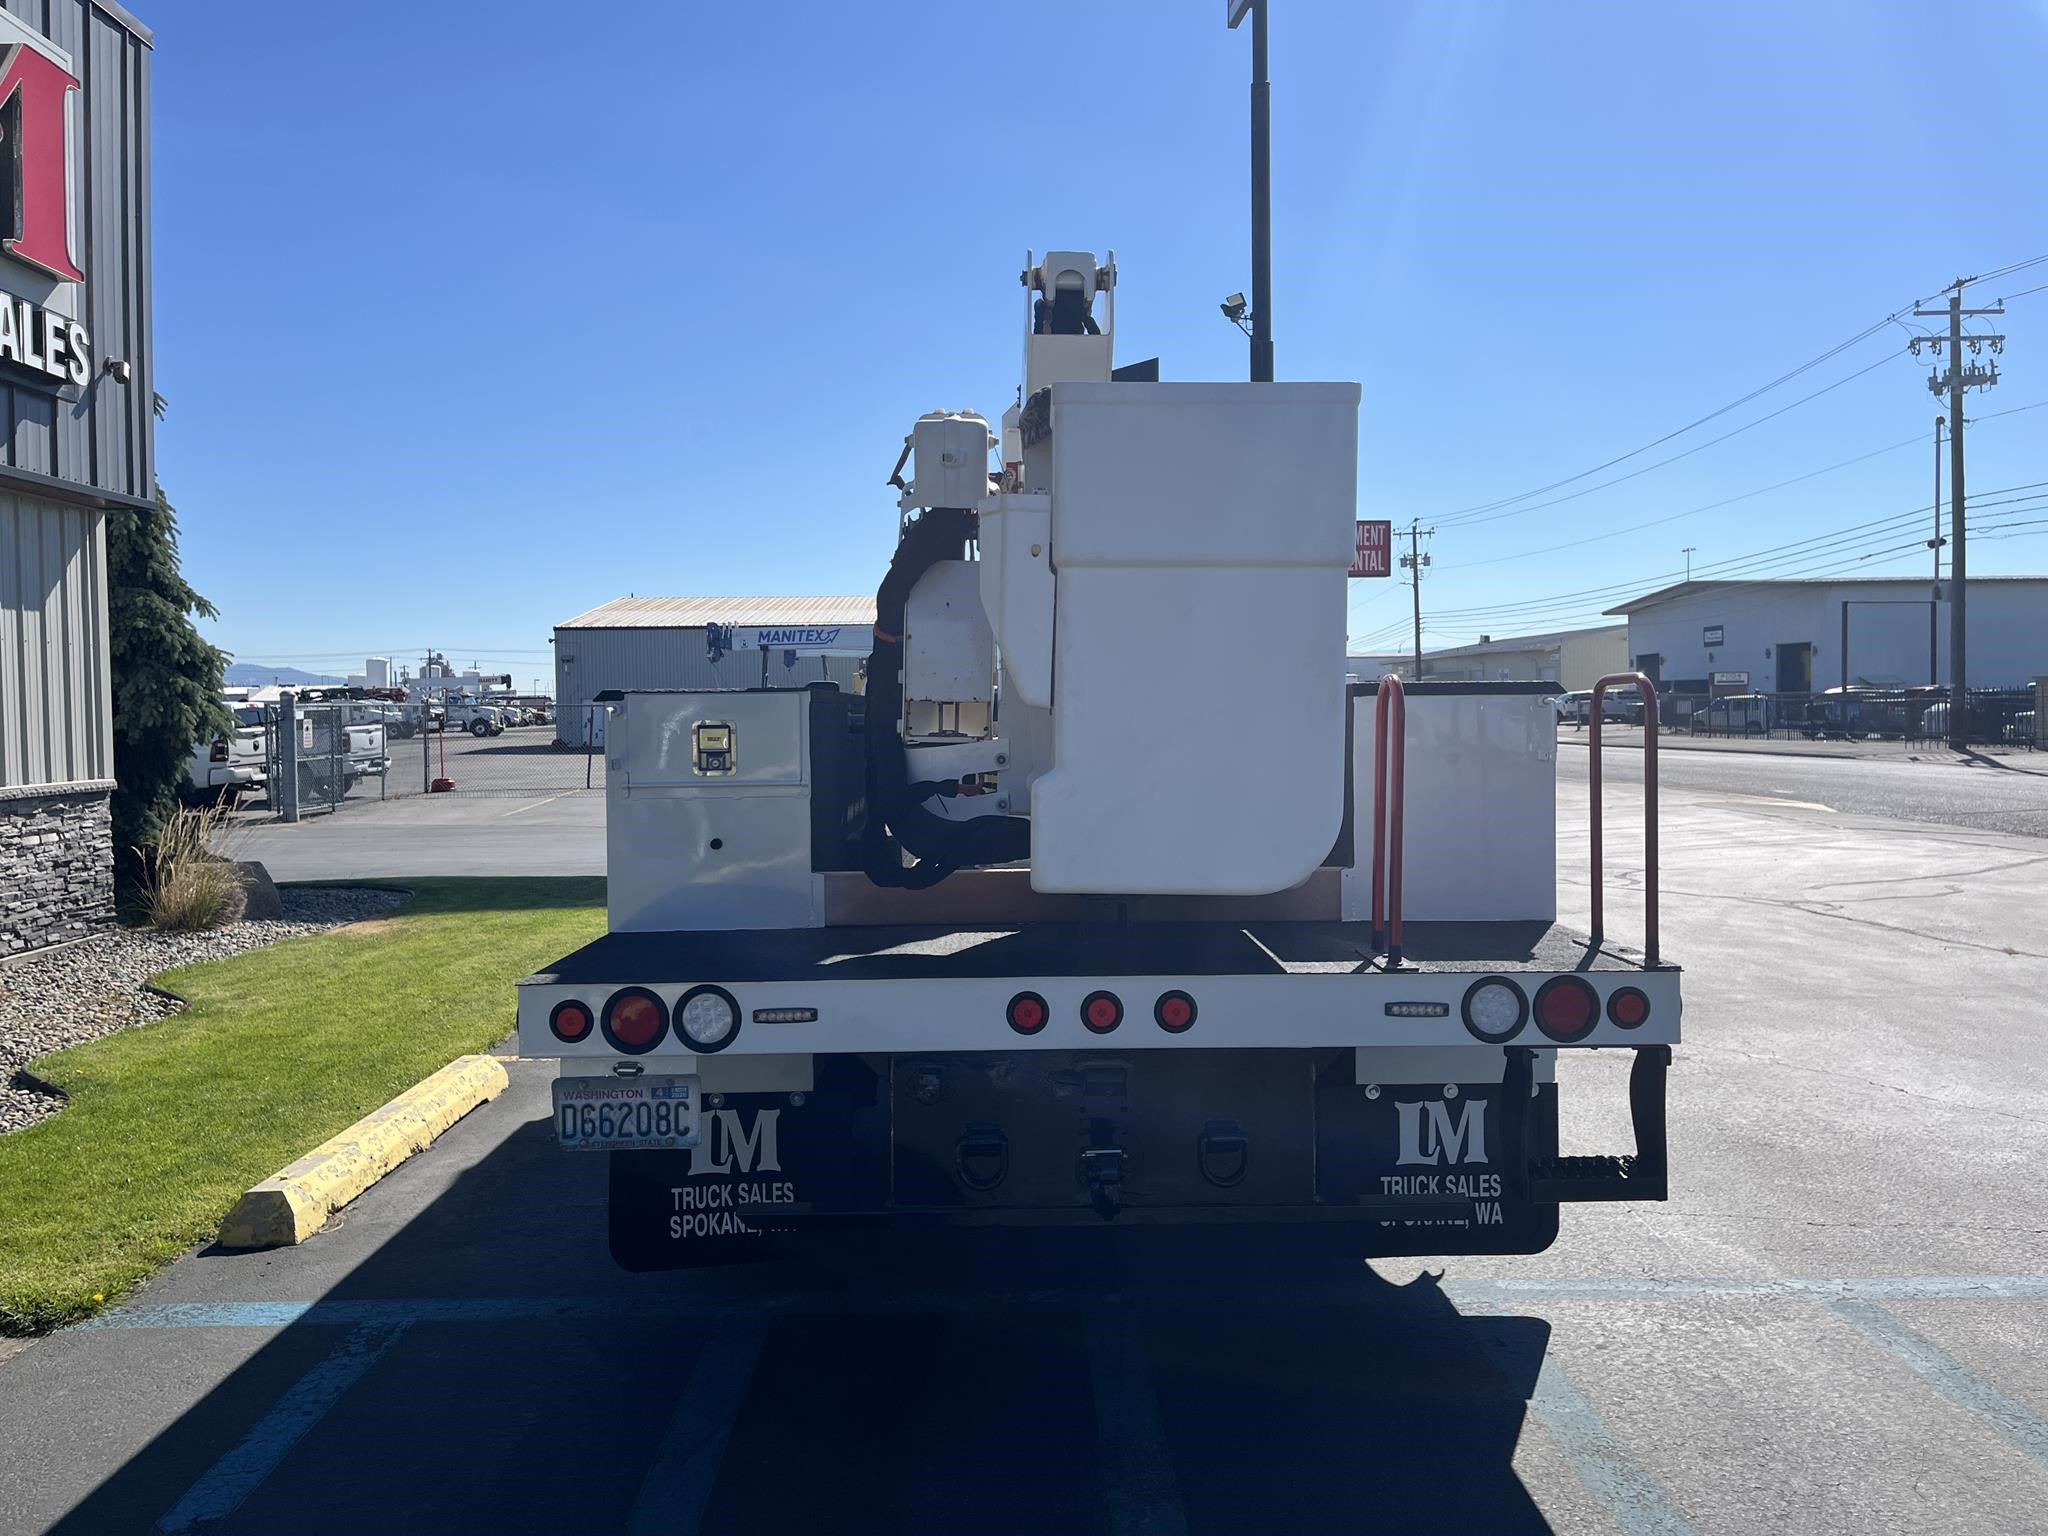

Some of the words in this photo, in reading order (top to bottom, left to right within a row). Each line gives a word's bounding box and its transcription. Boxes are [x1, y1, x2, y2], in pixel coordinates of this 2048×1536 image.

[758, 629, 824, 643] MANITEX
[564, 1089, 643, 1101] WASHINGTON
[561, 1101, 690, 1139] D66208C
[1394, 1099, 1489, 1166] LM
[687, 1109, 782, 1176] LM
[671, 1184, 733, 1211] TRUCK
[738, 1182, 795, 1204] SALES
[1380, 1175, 1440, 1195] TRUCK
[1445, 1174, 1502, 1198] SALES
[670, 1211, 762, 1239] SPOKAN,
[1475, 1202, 1504, 1225] WA
